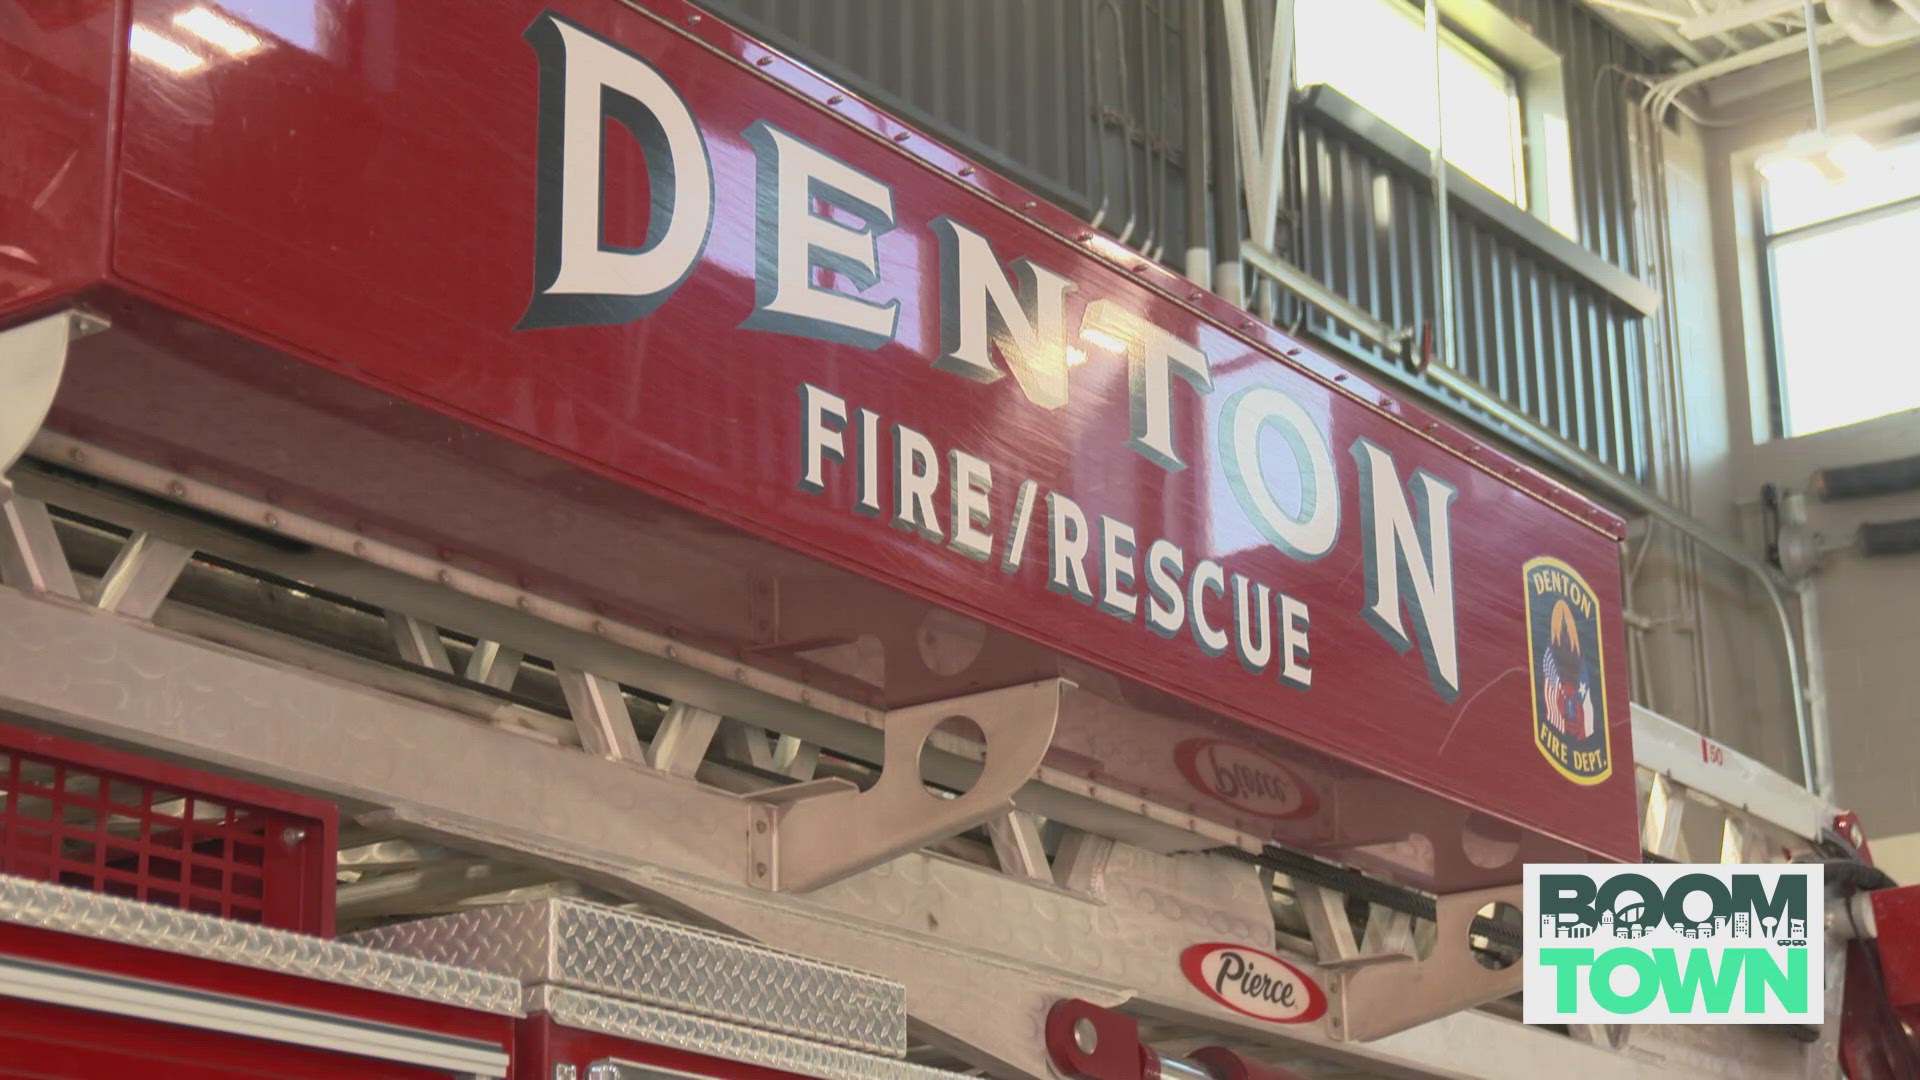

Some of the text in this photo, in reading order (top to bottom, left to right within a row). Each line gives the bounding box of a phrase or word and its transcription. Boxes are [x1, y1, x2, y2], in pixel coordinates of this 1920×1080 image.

[514, 8, 1460, 702] DENTON
[796, 381, 1314, 690] FIRE/RESCUE
[1533, 570, 1591, 619] DENTON
[1540, 724, 1607, 772] FIRE DEPT.
[1216, 951, 1296, 1008] Pierce
